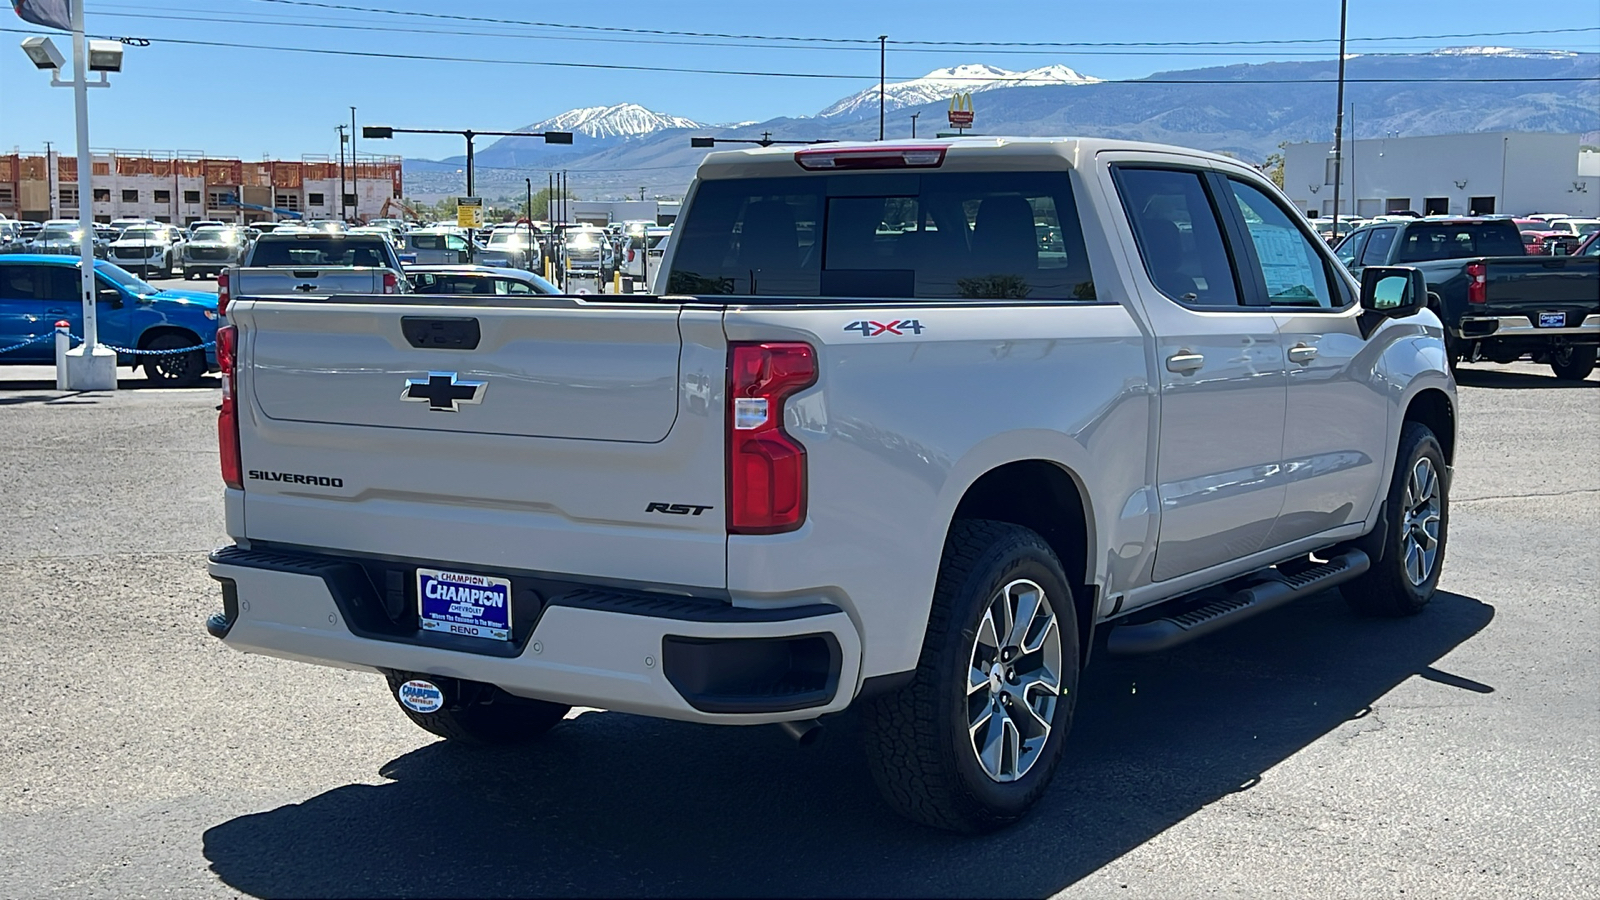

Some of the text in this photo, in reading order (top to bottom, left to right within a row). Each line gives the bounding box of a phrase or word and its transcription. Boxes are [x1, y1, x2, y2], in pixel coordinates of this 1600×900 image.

[248, 469, 344, 488] SILVERADO
[645, 502, 714, 516] RST
[441, 573, 484, 585] CHAMPION
[425, 579, 504, 608] CHAMPION
[451, 604, 482, 615] CHEVROLET
[450, 625, 479, 636] RENO
